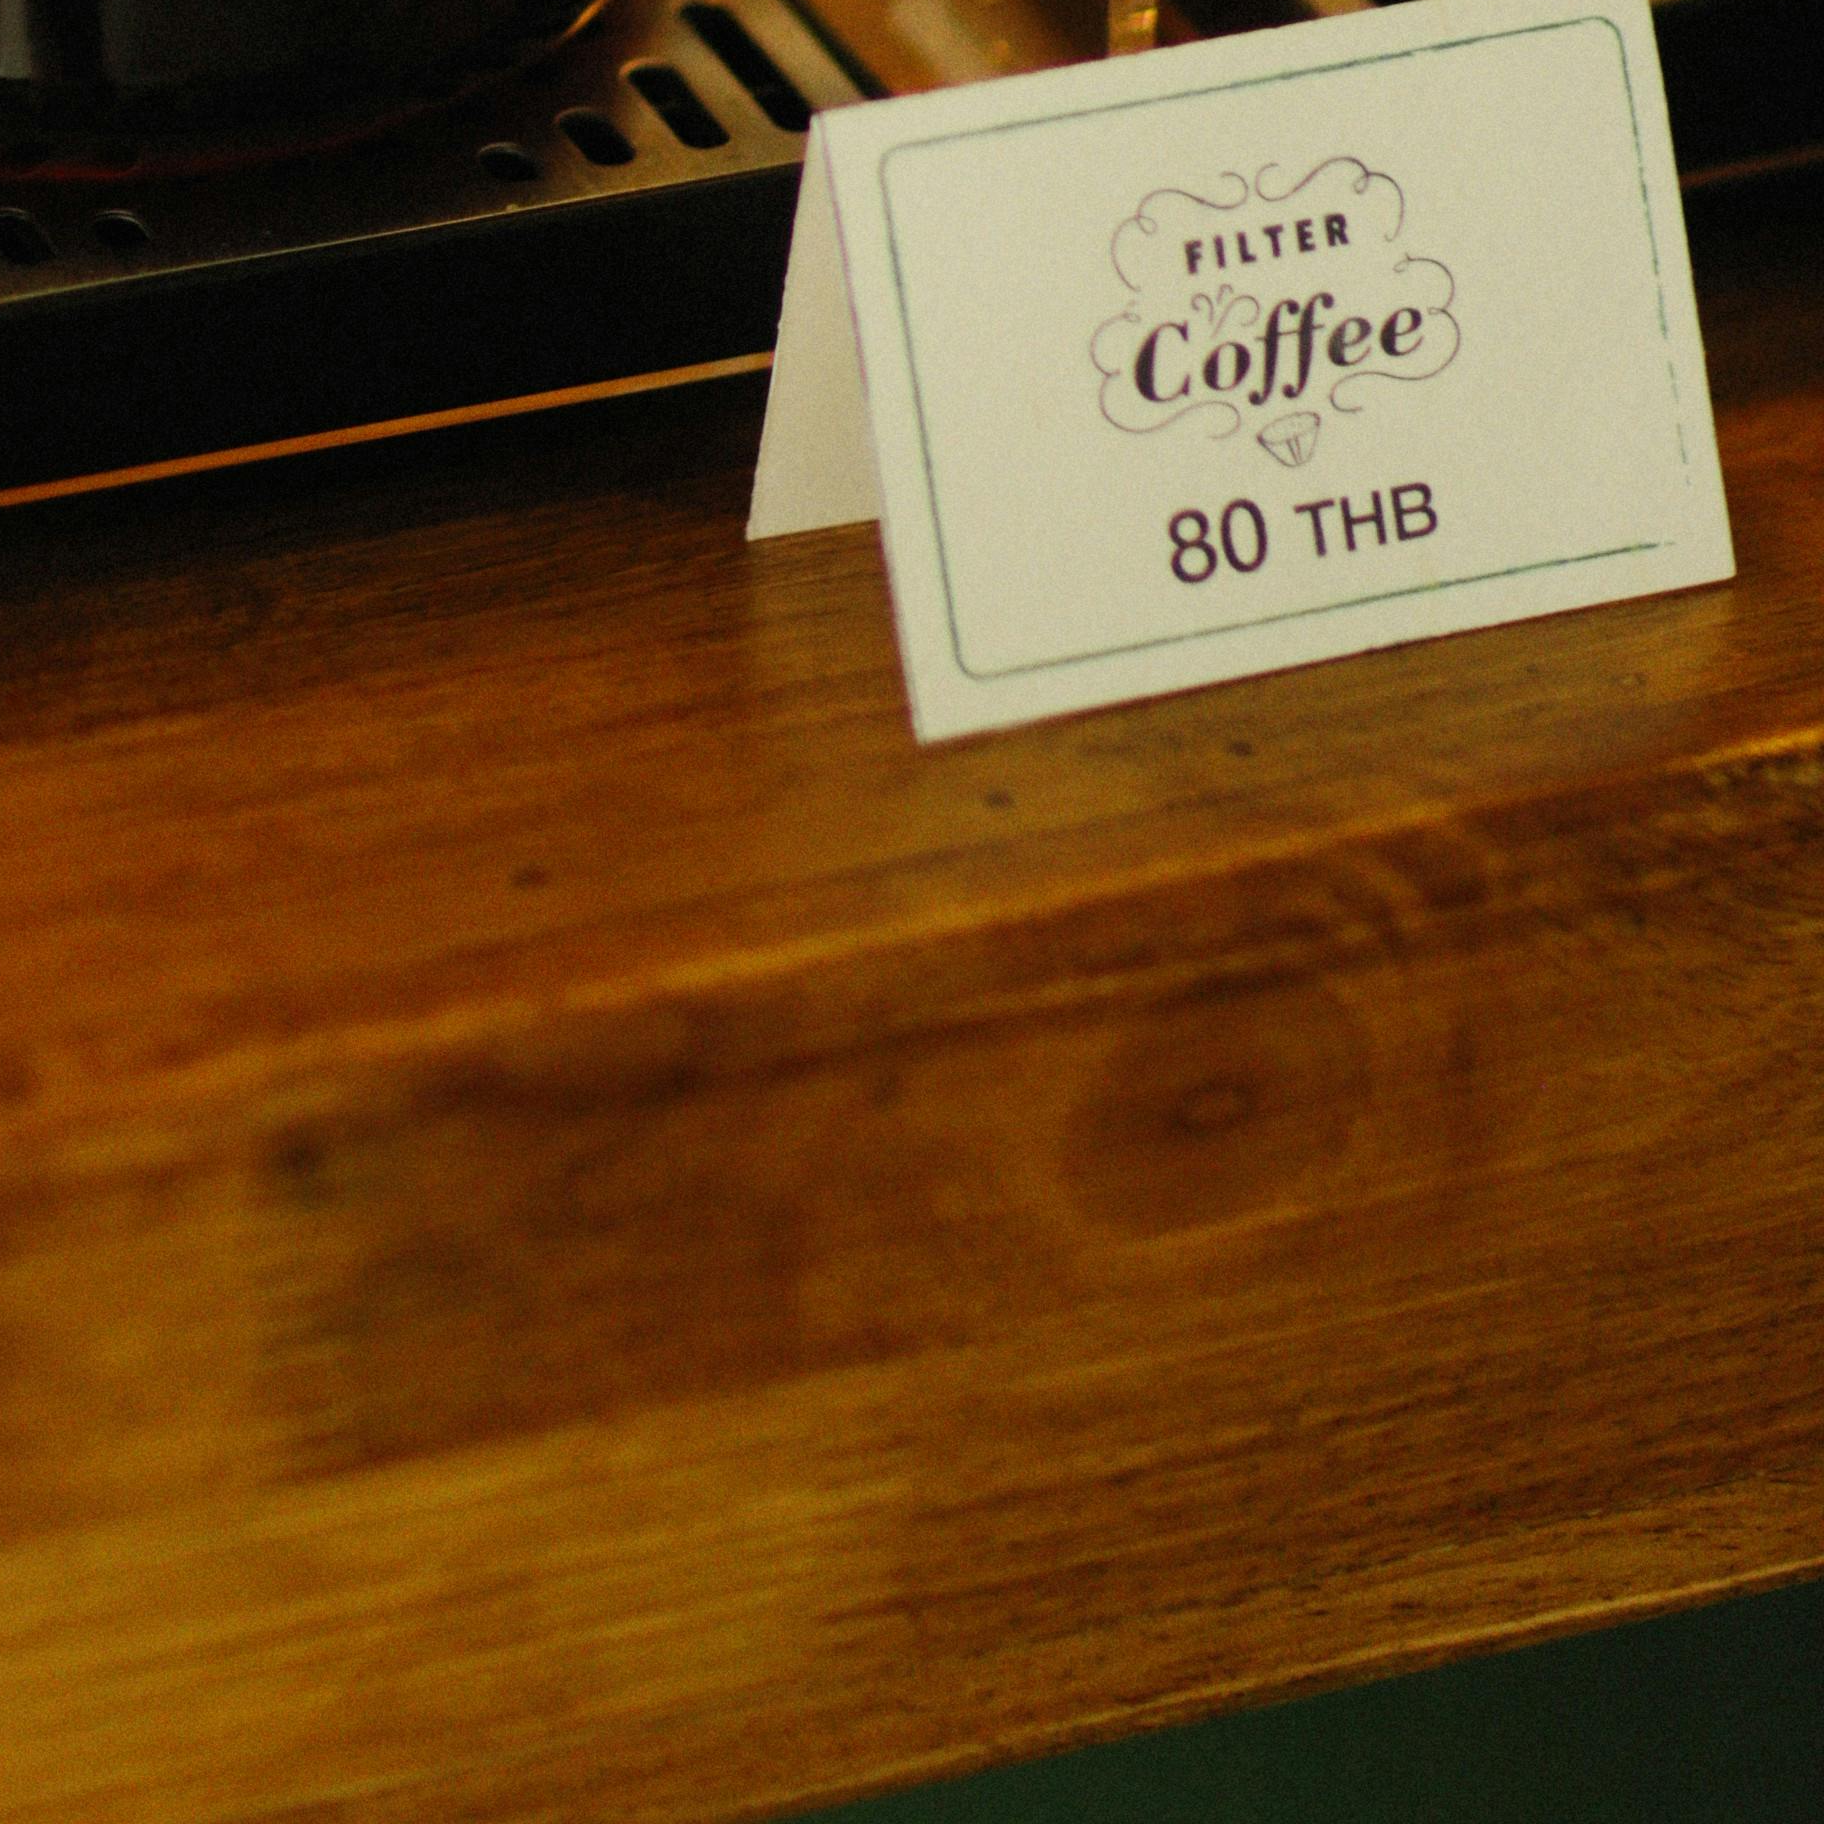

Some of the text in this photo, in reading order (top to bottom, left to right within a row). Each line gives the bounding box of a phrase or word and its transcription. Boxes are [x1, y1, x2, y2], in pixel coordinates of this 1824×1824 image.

[1184, 213, 1350, 275] FILTER
[1133, 291, 1424, 406] Coffee
[1168, 482, 1438, 584] 80 THB
